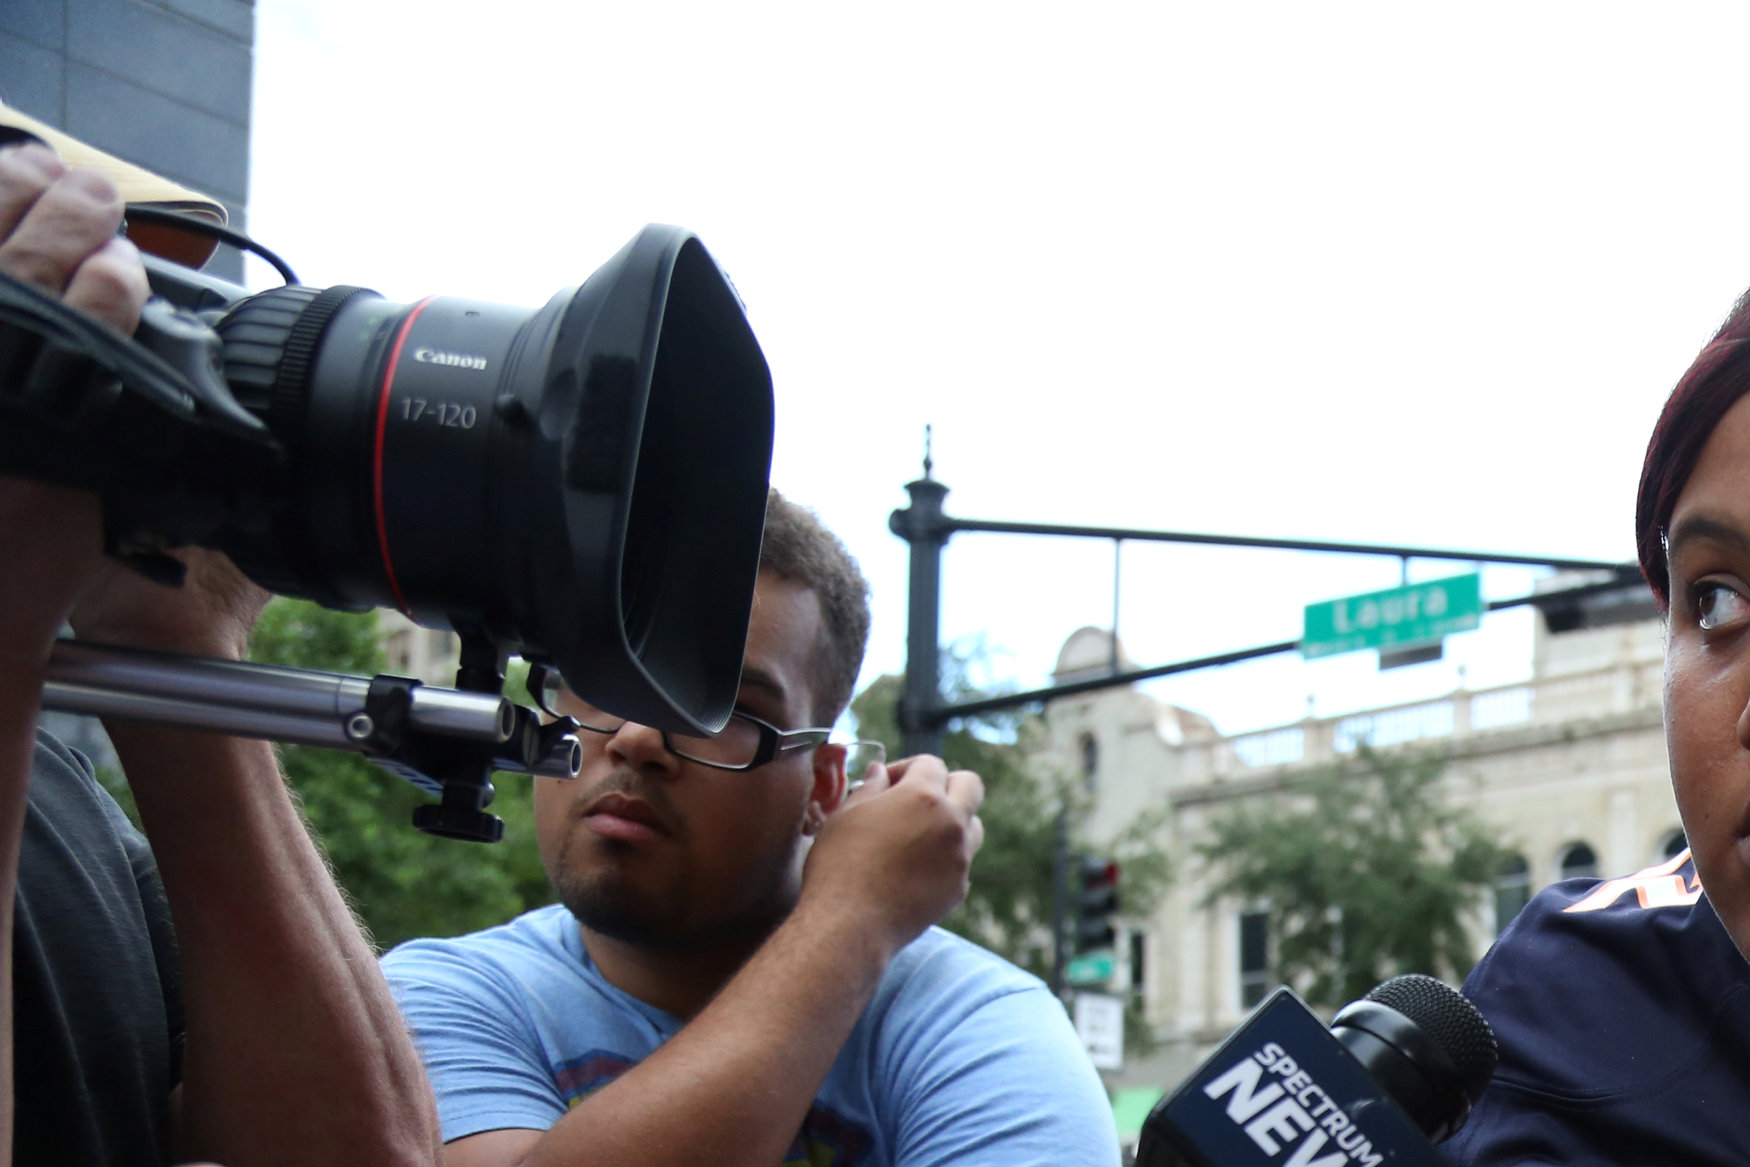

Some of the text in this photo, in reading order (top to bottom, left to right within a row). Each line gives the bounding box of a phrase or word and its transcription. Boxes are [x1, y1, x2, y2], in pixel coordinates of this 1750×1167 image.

[414, 348, 487, 370] Canon
[401, 397, 477, 429] 17-120
[1332, 585, 1449, 634] Laura
